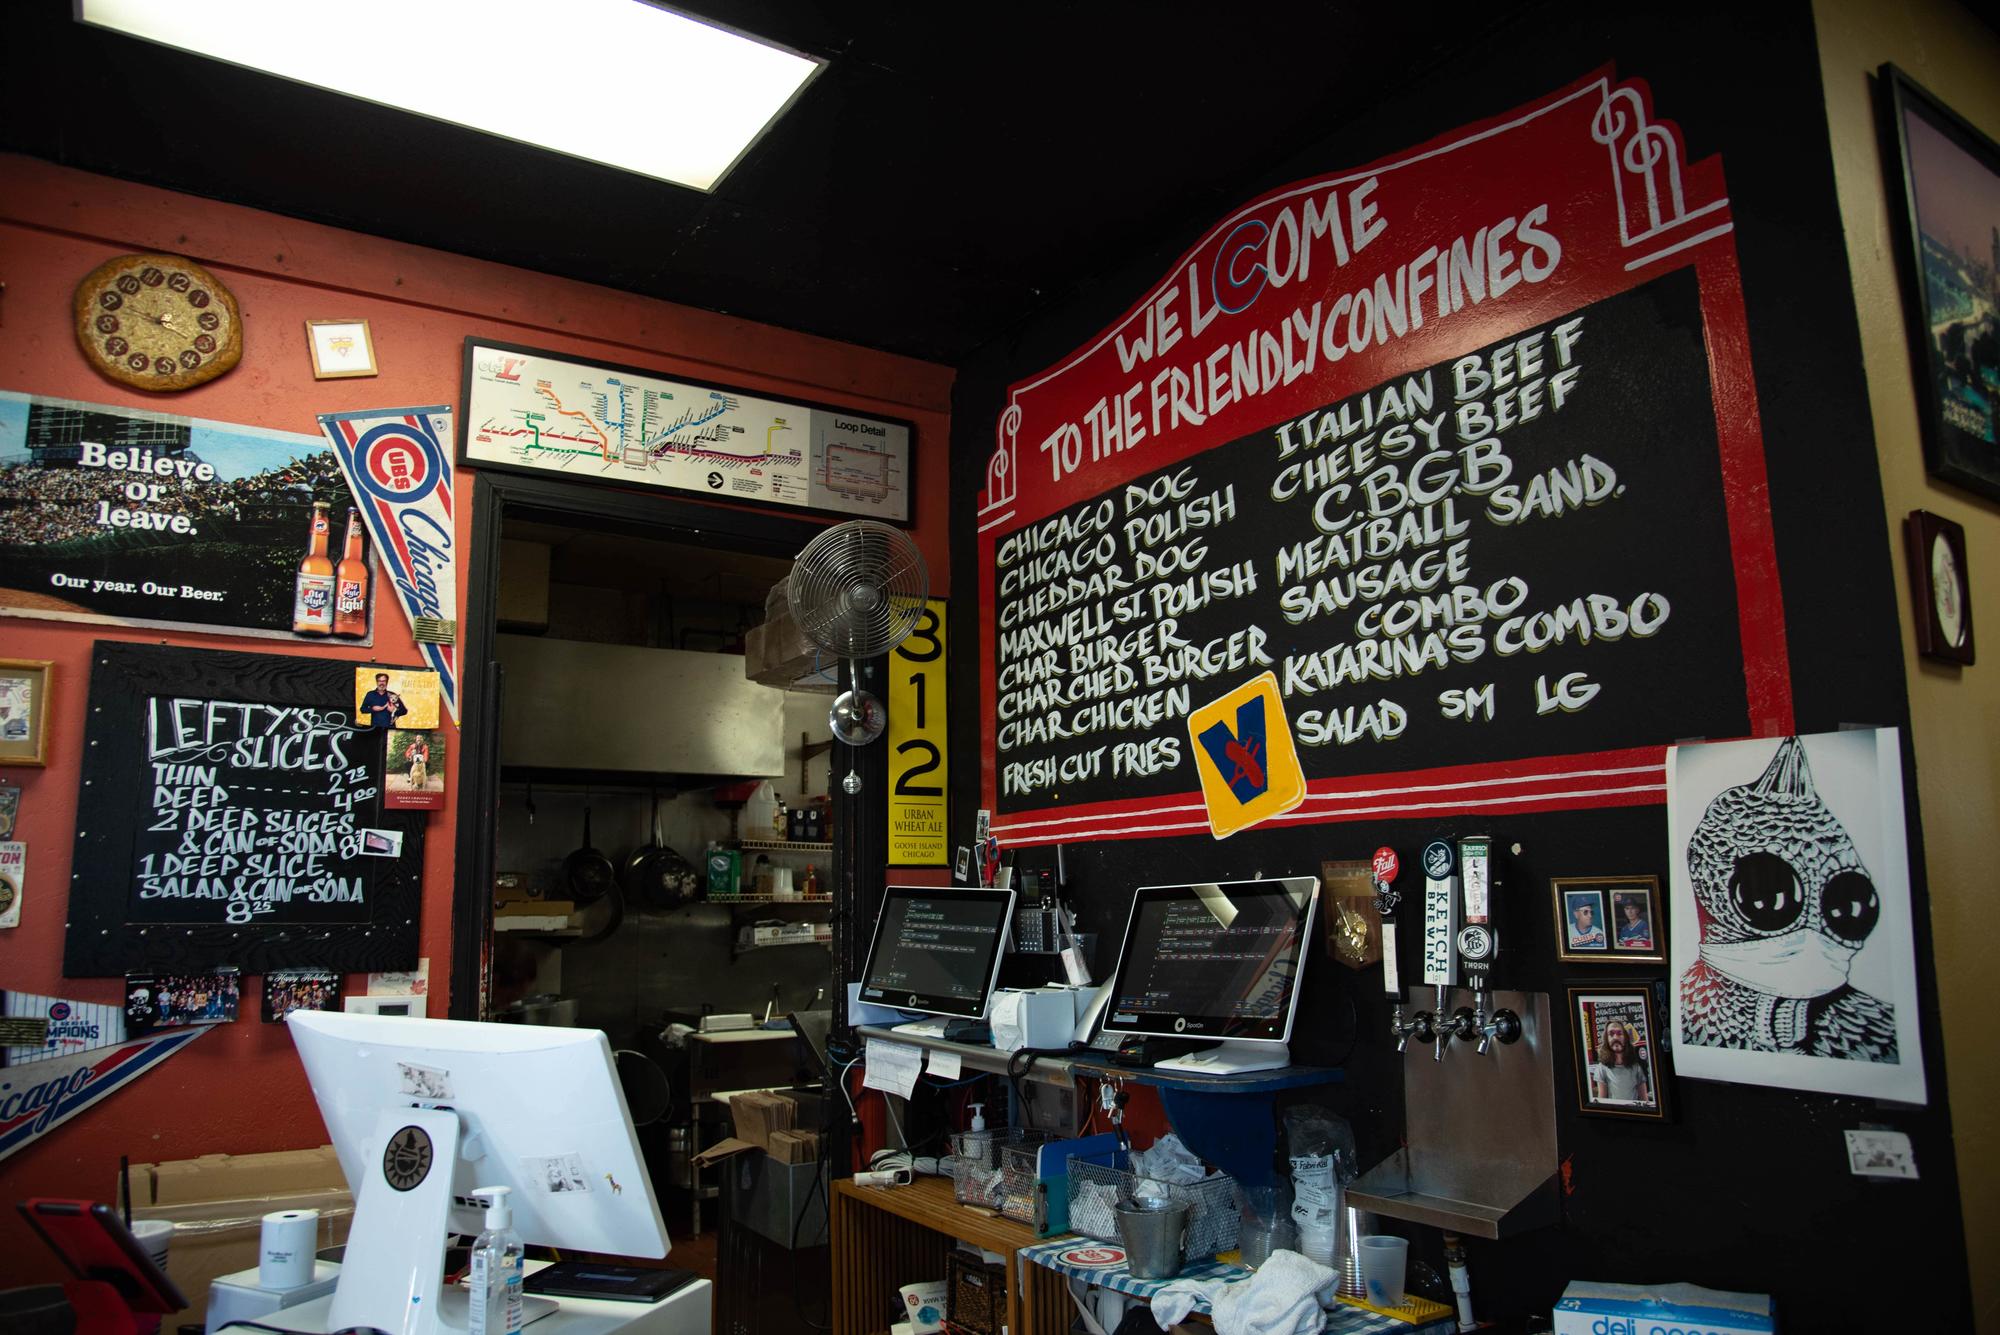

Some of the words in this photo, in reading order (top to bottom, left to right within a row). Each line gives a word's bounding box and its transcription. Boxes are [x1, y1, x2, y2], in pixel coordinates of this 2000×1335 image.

[121, 278, 137, 293] 10
[146, 271, 158, 284] 11
[172, 275, 189, 291] 12
[1115, 177, 1388, 373] WELCOME
[105, 294, 118, 308] 9
[194, 293, 202, 306] 1
[102, 315, 114, 331] 8
[203, 315, 216, 329] 2
[201, 337, 213, 351] 3
[1040, 422, 1083, 482] TO
[1083, 381, 1147, 463] THE
[1151, 301, 1322, 437] FRIENDLY
[1322, 204, 1562, 362] CONFINES
[131, 354, 143, 368] 6
[159, 359, 172, 373] 5
[184, 353, 197, 367] 4
[1275, 371, 1434, 459] ITALIAN
[1452, 316, 1584, 402] BEEF
[835, 419, 859, 433] Loop
[861, 424, 886, 437] Detail
[1271, 412, 1446, 500] CHEESY
[1455, 366, 1582, 444] BEEF
[78, 441, 215, 481] Believe
[125, 481, 167, 502] or
[97, 500, 198, 536] leave.
[997, 499, 1114, 567] CHICAGO
[1125, 467, 1199, 517] DOG
[1277, 499, 1470, 585] MEATBALL
[1485, 454, 1626, 525] SAND.
[1000, 533, 1116, 597] CHICAGO
[1124, 484, 1237, 554] POLISH
[51, 573, 89, 588] Our
[93, 577, 138, 594] year.
[142, 582, 177, 597] Our
[345, 582, 358, 590] Old
[1000, 566, 1133, 630] CHEDDAR
[1136, 537, 1209, 581] DOG
[1280, 540, 1470, 623] SAUSAGE
[304, 596, 327, 607] Style
[308, 589, 324, 599] Old
[337, 597, 363, 613] Light
[1000, 601, 1115, 664] MAXWELL
[1113, 594, 1147, 624] ST.
[1150, 560, 1258, 620] POLISH
[1354, 576, 1529, 640] COMBO
[999, 650, 1068, 691] CHAR
[1070, 618, 1192, 674] BURGER
[1282, 624, 1486, 697] KATARINA'S
[1494, 592, 1670, 655] COMBO
[999, 680, 1072, 721] CHAR
[1068, 662, 1138, 699] CHED.
[1138, 624, 1275, 687] BURGER
[998, 711, 1074, 751] CHAR
[1072, 684, 1190, 734] CHICKEN
[1295, 698, 1408, 745] SALAD
[1438, 683, 1495, 722] SM
[1535, 672, 1601, 714] LG
[149, 697, 315, 761] LEFTY'S
[231, 730, 353, 771] SLICES
[152, 763, 216, 786] THIN
[1004, 755, 1058, 796] FRESH
[1059, 747, 1105, 781] CUT
[1112, 737, 1181, 778] FRIES
[153, 785, 229, 809] DEEP
[147, 808, 180, 831] 2
[187, 807, 259, 832] DEEP
[904, 808, 934, 820] URBAN
[894, 821, 926, 832] WHEAT
[928, 821, 944, 832] ALE
[178, 831, 201, 855] &
[204, 830, 257, 855] CAN
[277, 831, 337, 855] SODA
[894, 842, 918, 850] GOOSE
[919, 842, 943, 850] ISLAND
[902, 850, 935, 858] CHICAGO
[137, 854, 158, 878] 1
[162, 853, 239, 877] DEEP
[1373, 855, 1396, 873] Fall
[140, 877, 229, 899] SALAD
[229, 876, 249, 901] &
[248, 878, 295, 902] CAN
[308, 877, 364, 903] SODA
[1426, 891, 1435, 972] BREWING
[1435, 891, 1448, 973] KETCH
[1463, 961, 1489, 970] THORN
[46, 1025, 99, 1039] MPIONS
[1186, 1021, 1204, 1030] SpotOn
